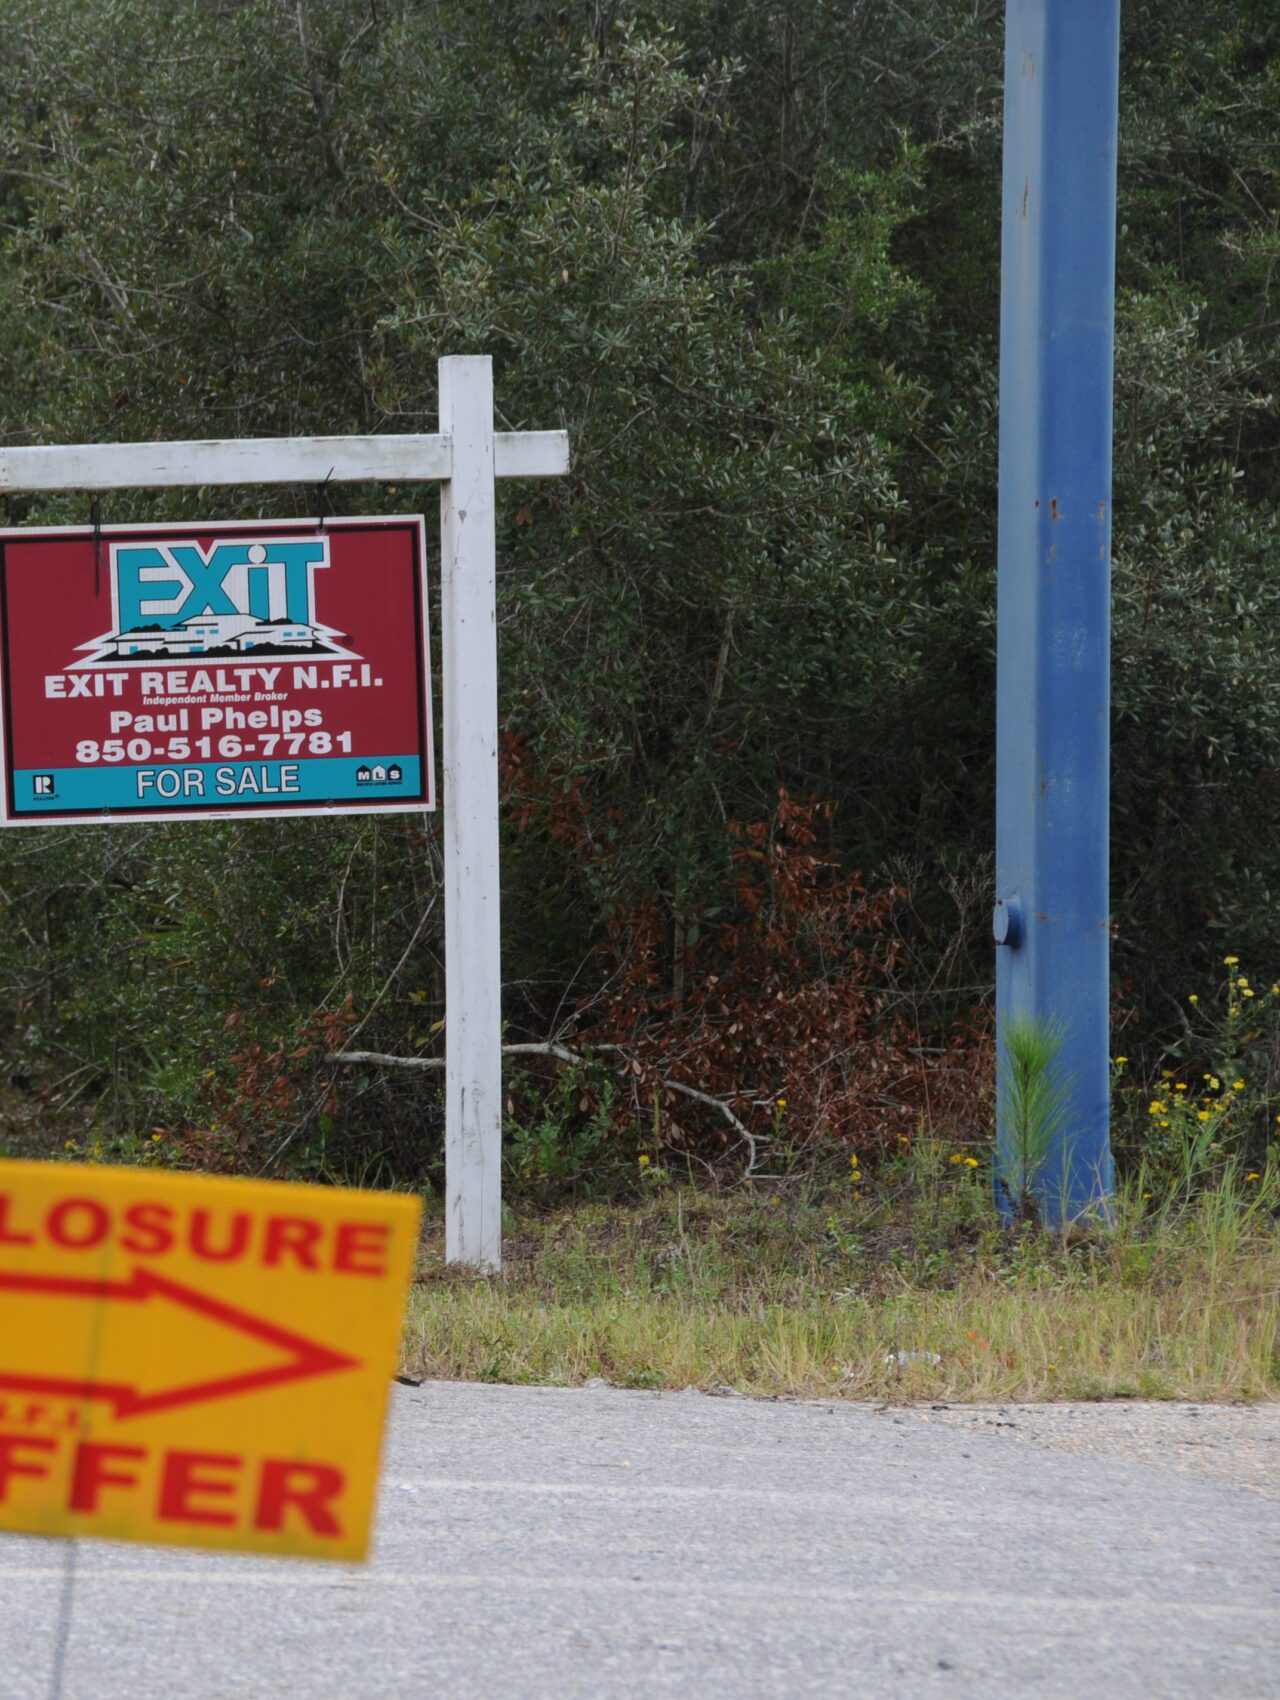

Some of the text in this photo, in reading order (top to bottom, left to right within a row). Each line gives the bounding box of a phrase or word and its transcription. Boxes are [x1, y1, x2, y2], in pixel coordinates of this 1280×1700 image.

[44, 664, 384, 699] EXIT REALTY N.F.I.
[142, 691, 288, 706] Independent Member Broker
[109, 705, 323, 734] Paul Phelps
[75, 731, 353, 763] 850-516-7781
[136, 765, 301, 799] FOR SALE
[357, 769, 401, 781] MLS
